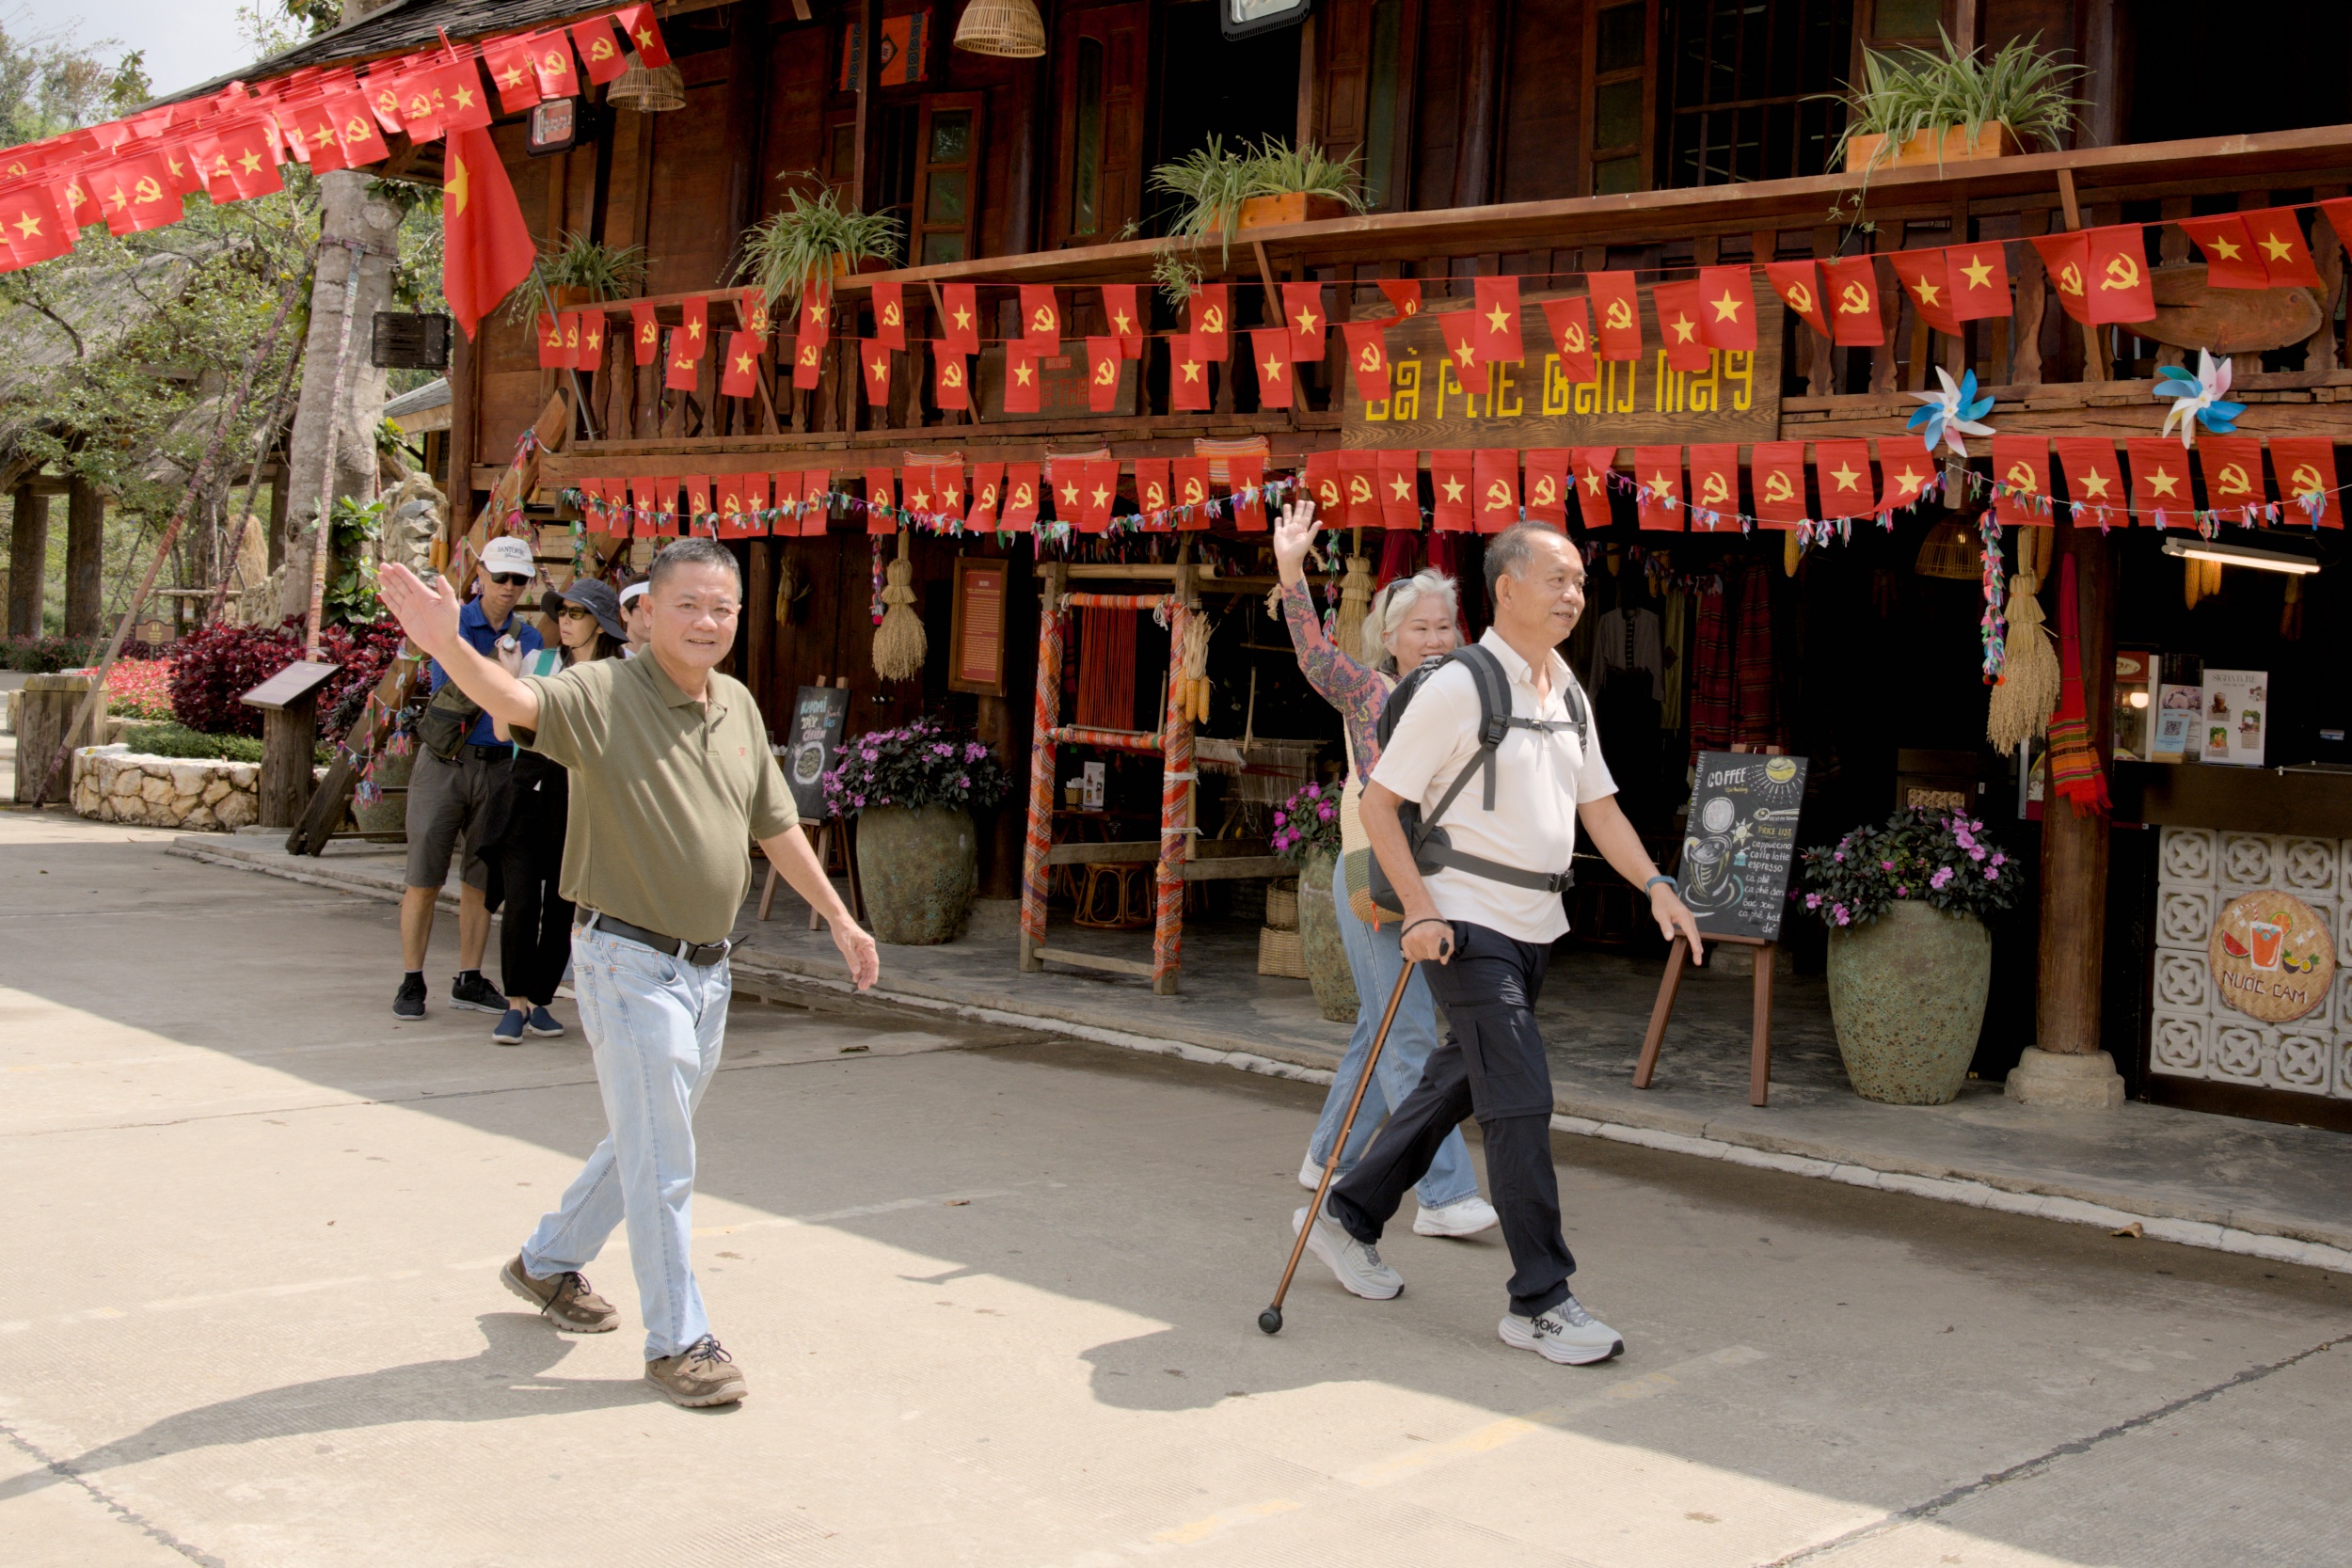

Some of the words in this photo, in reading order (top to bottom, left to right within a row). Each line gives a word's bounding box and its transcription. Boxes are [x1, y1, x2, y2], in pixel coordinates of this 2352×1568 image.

[1707, 767, 1747, 788] COFFEE
[1757, 826, 1776, 835] PRICE
[1778, 828, 1792, 836] LIST
[1752, 840, 1792, 851] cappuccino
[1772, 850, 1790, 862] latte
[1747, 861, 1784, 873] espresso
[2273, 984, 2309, 1006] CAM
